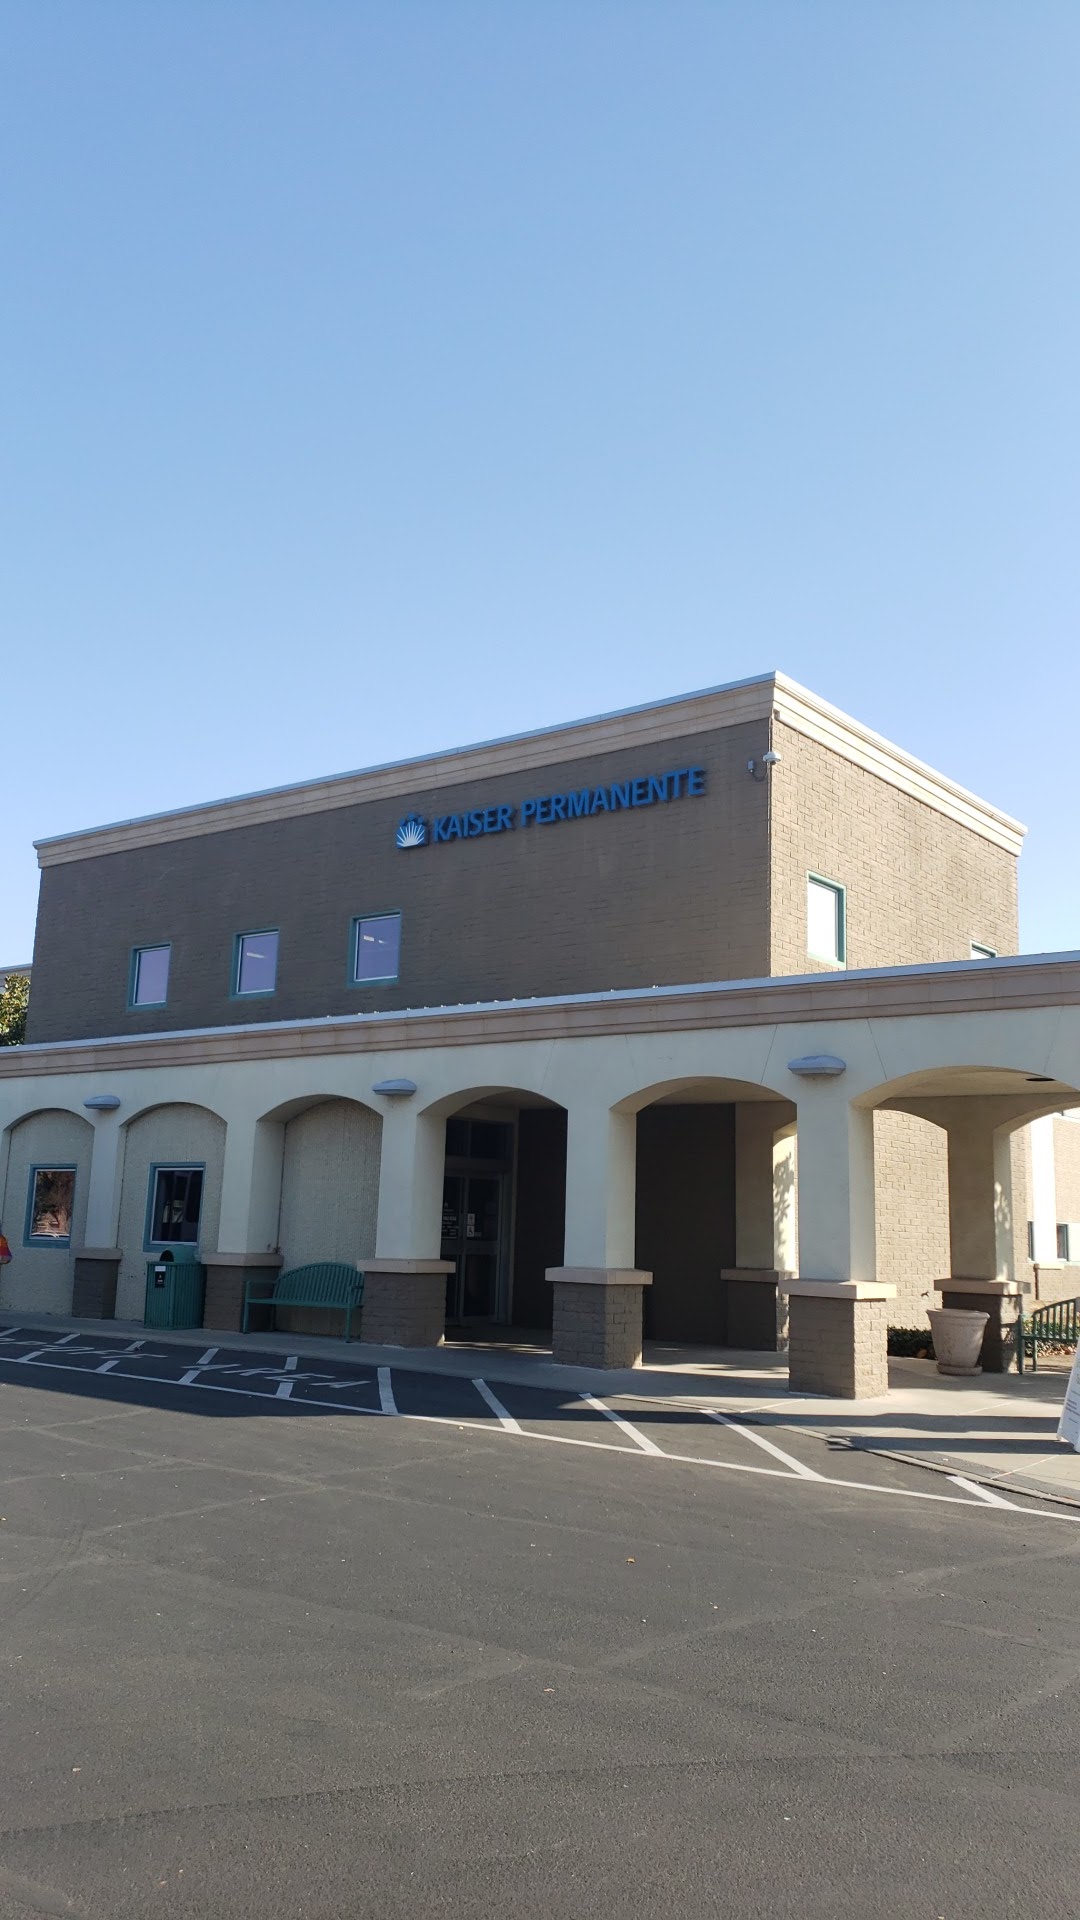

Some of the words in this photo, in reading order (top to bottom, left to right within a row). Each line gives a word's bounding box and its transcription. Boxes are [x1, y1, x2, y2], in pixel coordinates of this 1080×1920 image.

[433, 804, 513, 843] KAISER
[520, 766, 707, 828] PERMANENTE
[180, 1363, 372, 1389] AREA
